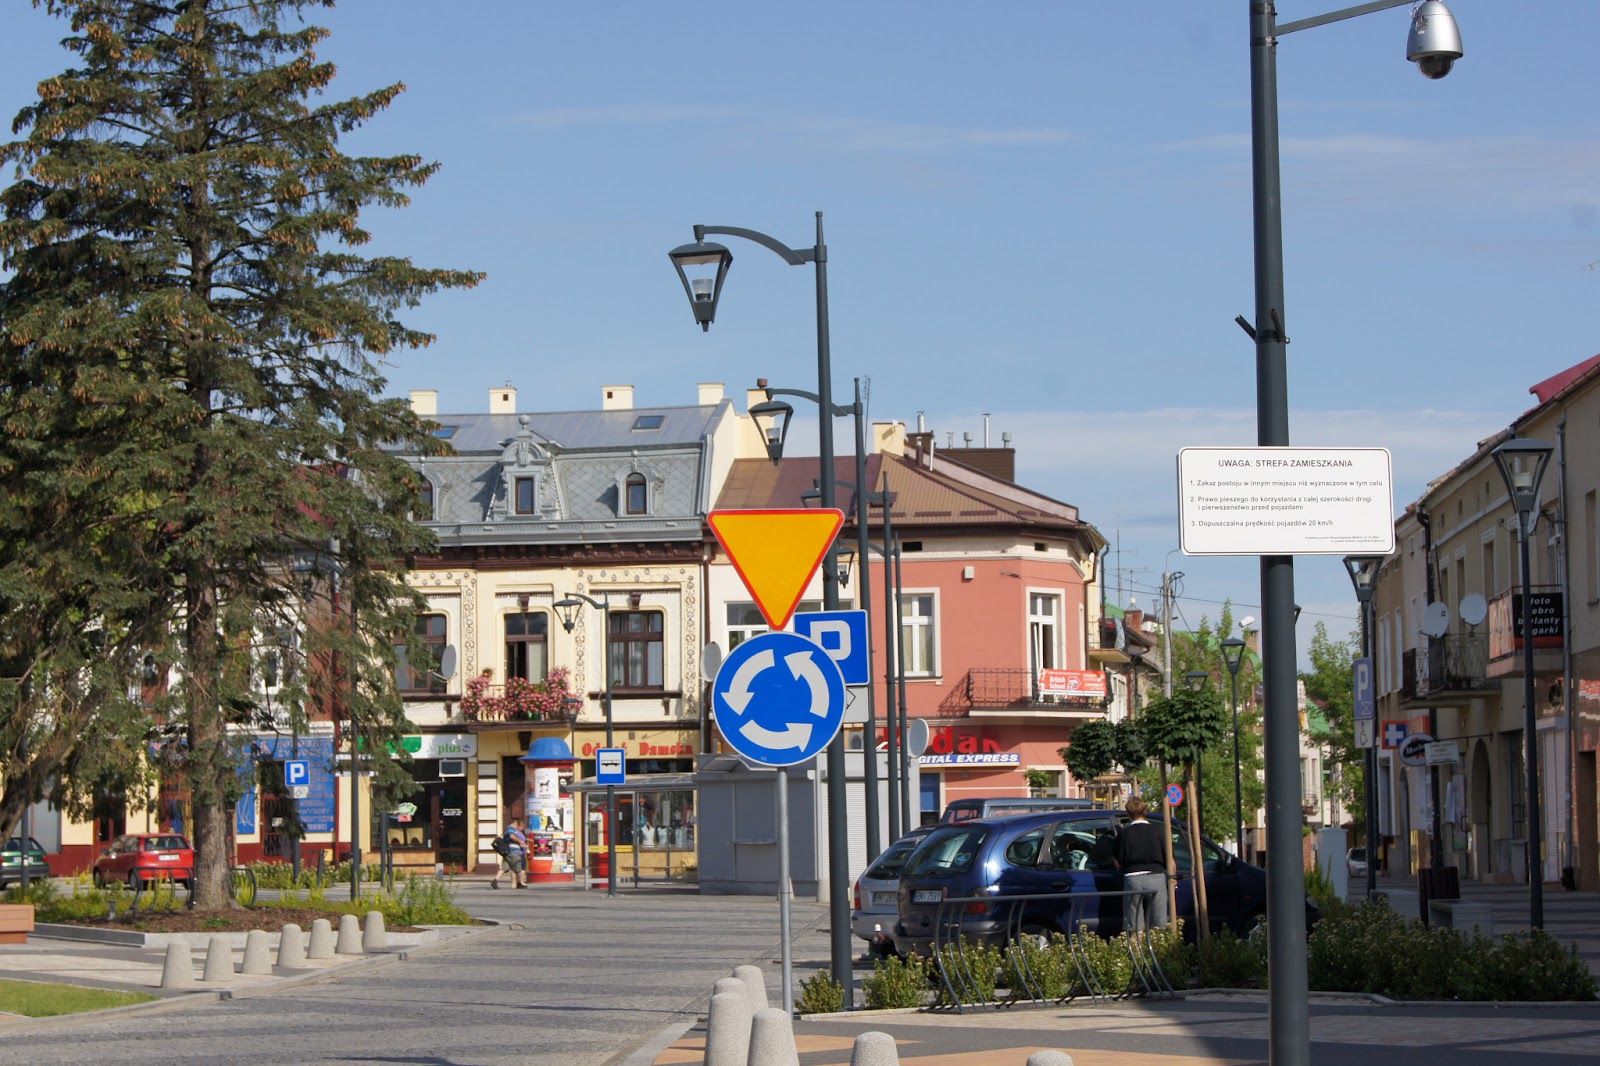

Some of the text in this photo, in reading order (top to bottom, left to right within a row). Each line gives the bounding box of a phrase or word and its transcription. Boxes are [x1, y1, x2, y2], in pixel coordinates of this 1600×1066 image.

[1218, 459, 1353, 467] UWAGA: STREFA ZAMIESZKANIA
[1517, 617, 1560, 625] blanty
[1520, 627, 1558, 636] zgarki
[810, 620, 851, 660] P
[1357, 663, 1369, 700] P
[437, 743, 462, 755] plus
[639, 742, 693, 756] Damska
[919, 754, 1019, 764] GITAL EXPRESS
[290, 763, 305, 784] P
